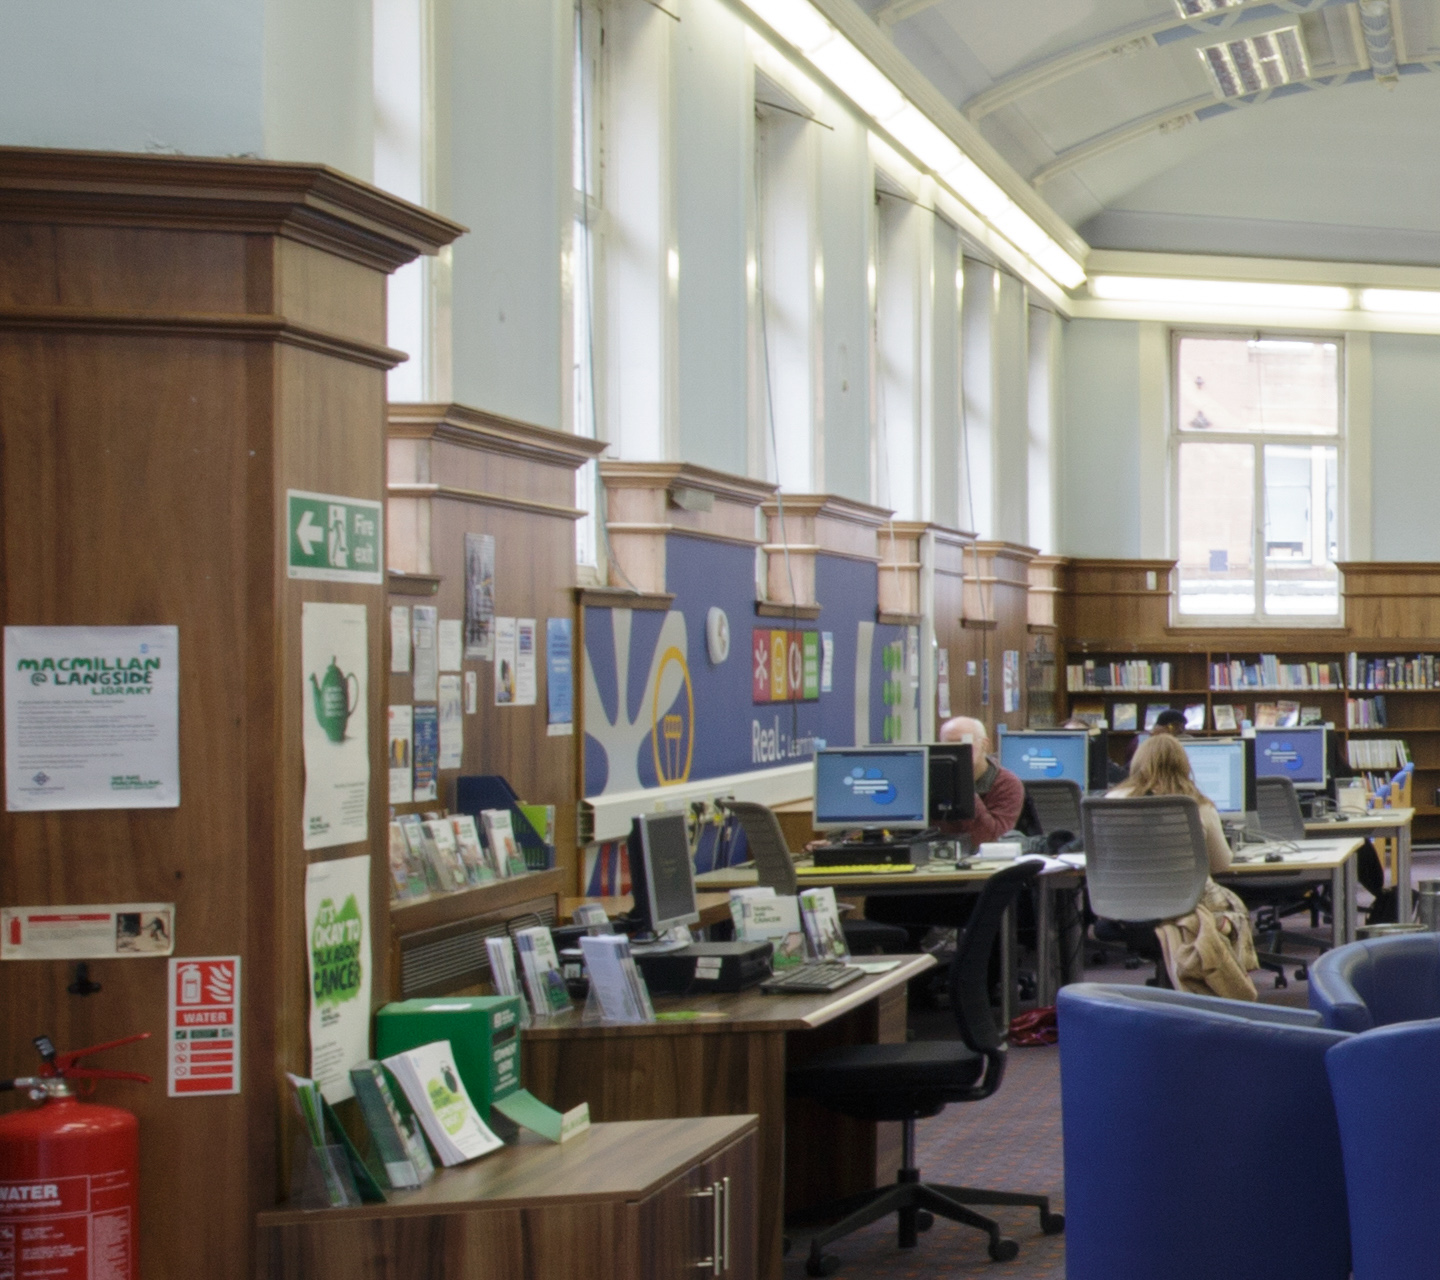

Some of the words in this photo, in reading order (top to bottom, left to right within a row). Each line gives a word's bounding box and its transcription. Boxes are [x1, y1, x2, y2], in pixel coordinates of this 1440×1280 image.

[355, 514, 374, 537] Fire
[355, 545, 374, 565] exit
[17, 657, 161, 671] MACMILLAN
[30, 672, 47, 686] @
[54, 671, 153, 685] LANGSIDE
[91, 686, 153, 695] LIBRARY
[752, 715, 786, 763] Real:
[787, 729, 817, 757] Learnin
[315, 922, 342, 946] OKAY
[314, 966, 361, 997] CANCER
[183, 1011, 228, 1024] WATER
